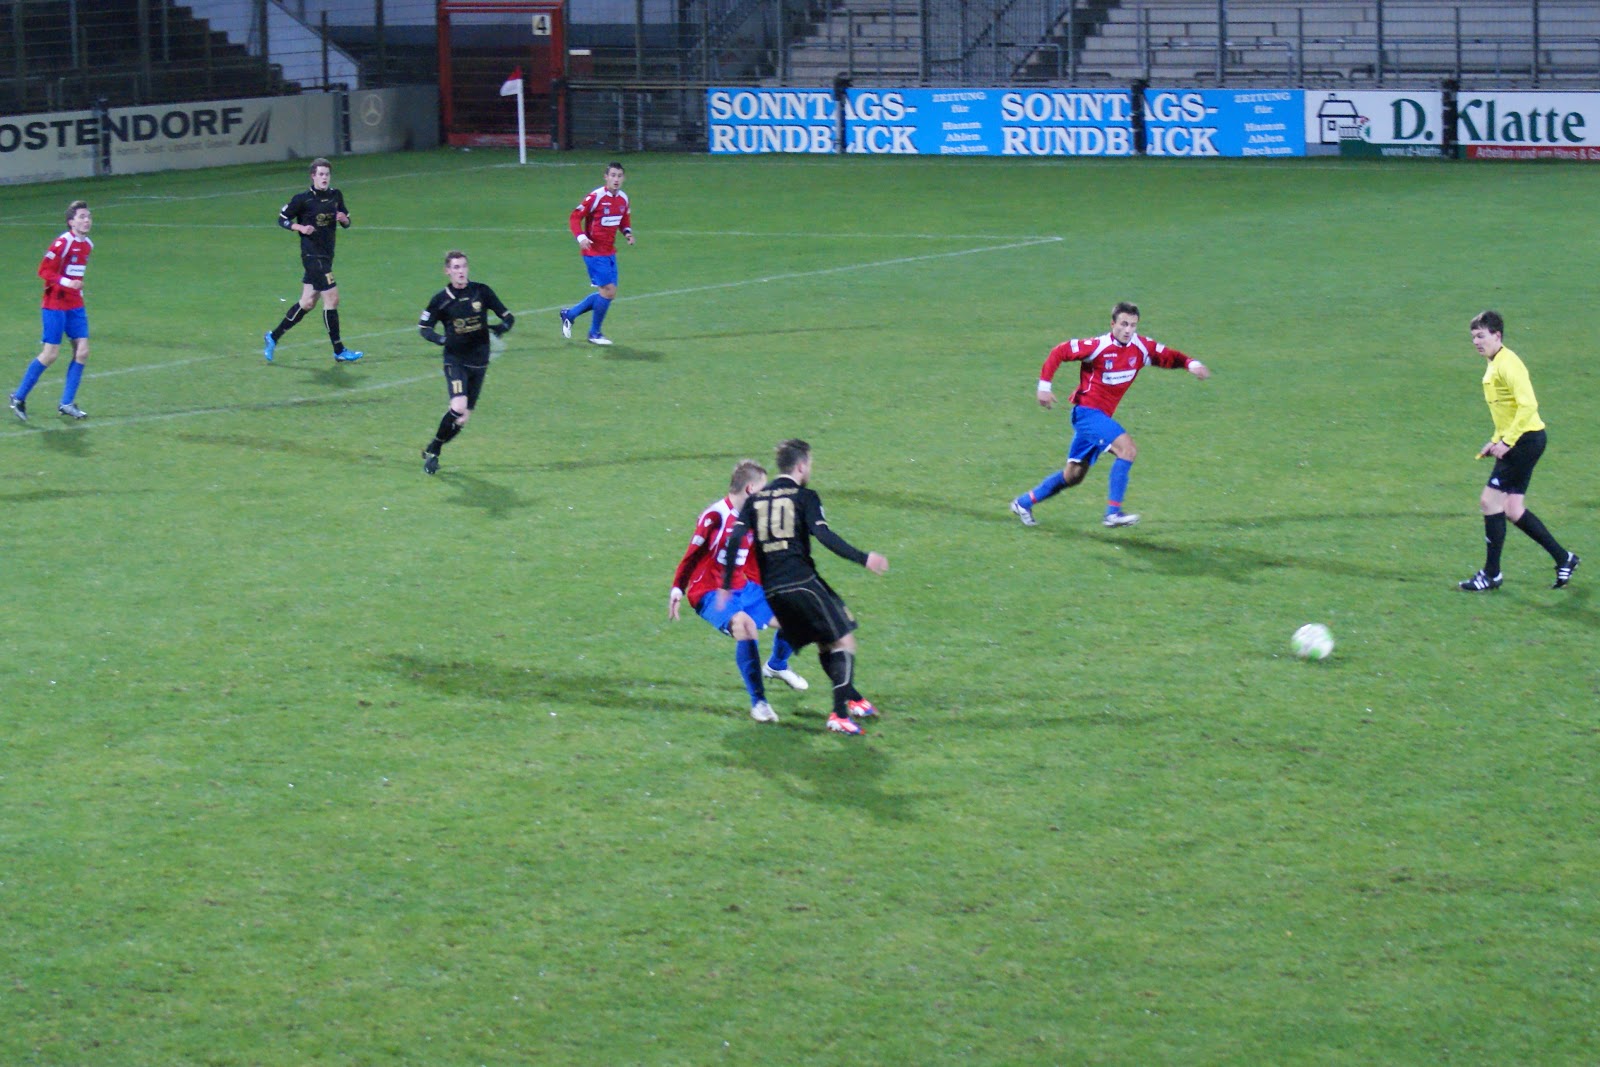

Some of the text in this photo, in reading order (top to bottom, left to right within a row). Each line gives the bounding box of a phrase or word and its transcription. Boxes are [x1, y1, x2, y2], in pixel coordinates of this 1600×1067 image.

[535, 15, 547, 34] 4
[0, 107, 243, 153] OSTENDORF
[1390, 98, 1586, 143] D. Klatte
[753, 497, 795, 541] 10
